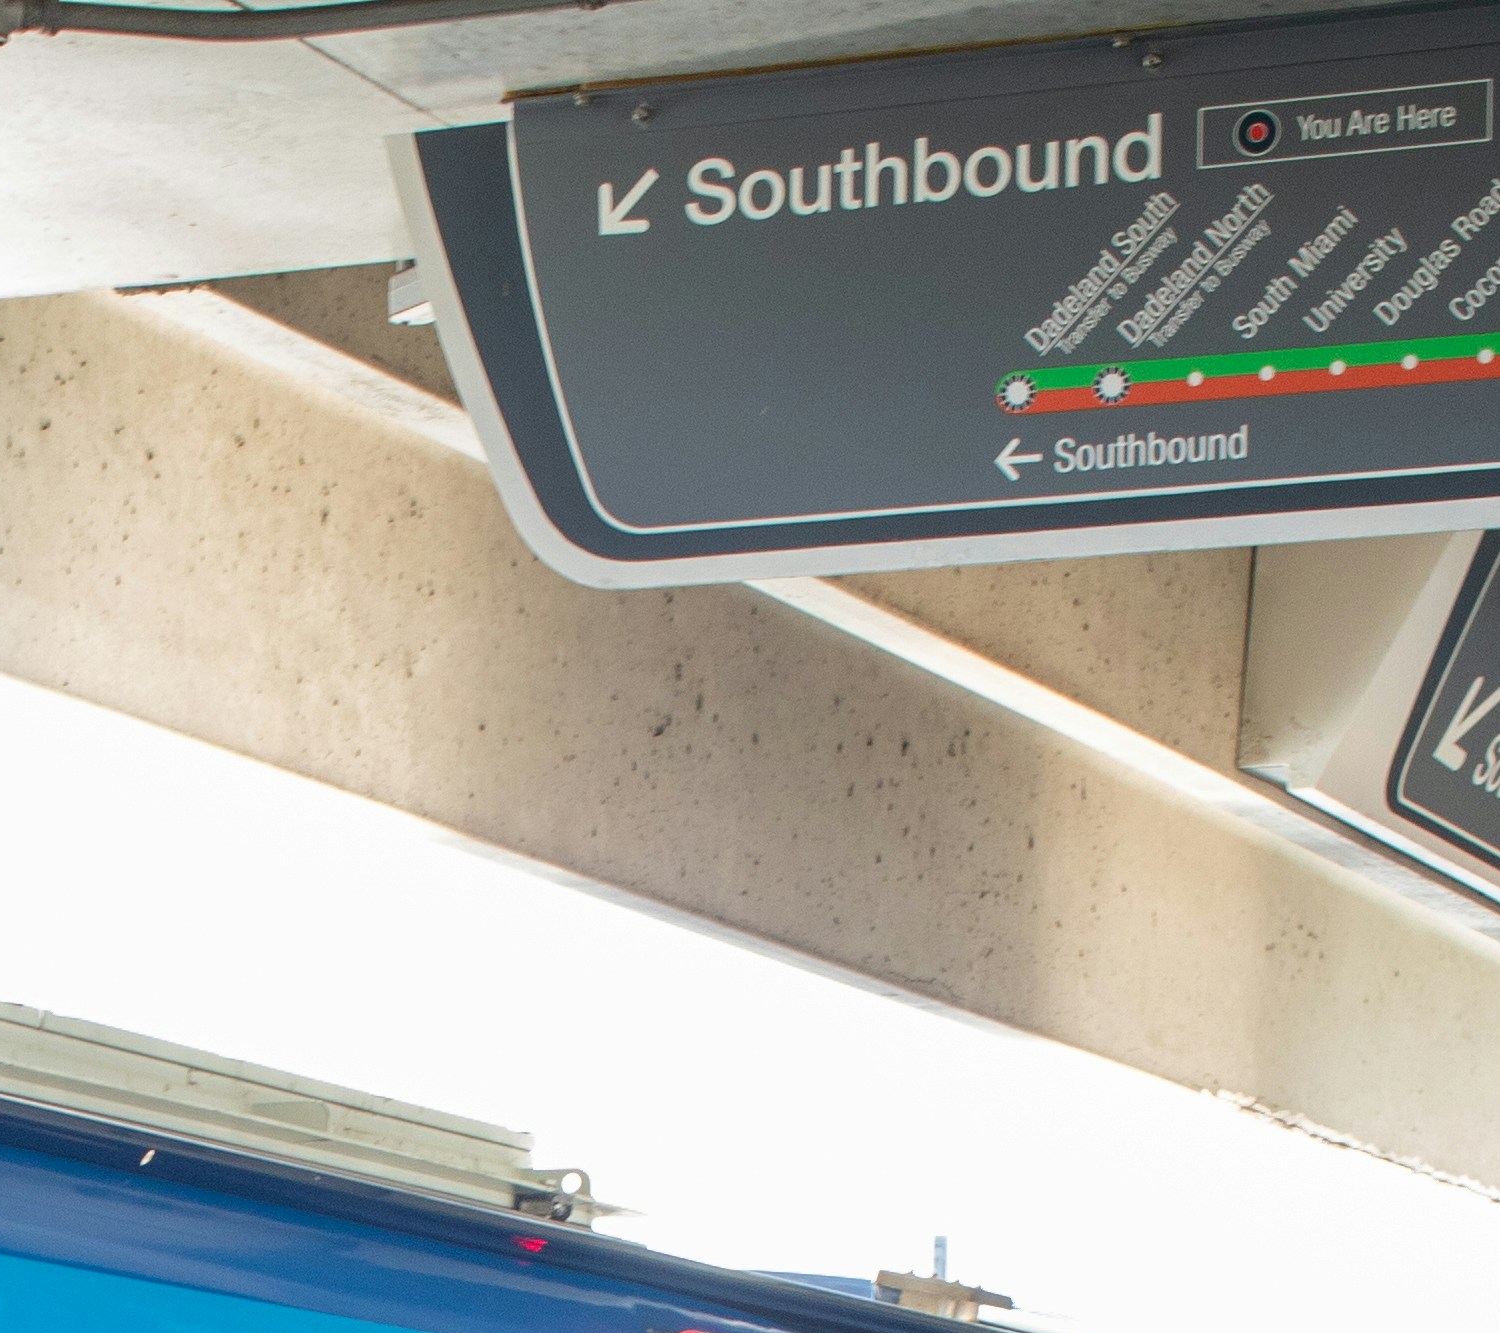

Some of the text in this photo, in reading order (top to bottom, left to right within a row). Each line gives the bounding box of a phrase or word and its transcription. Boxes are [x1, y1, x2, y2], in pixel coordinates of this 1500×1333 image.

[683, 112, 1162, 225] Southbound
[1296, 102, 1458, 142] You Are Here
[1024, 191, 1177, 353] Dadeland South
[1057, 226, 1178, 354] Transfer to Busway
[1116, 183, 1270, 345] Dadeland North
[1148, 219, 1271, 347] Transfer to Busway
[1231, 205, 1359, 339] South Miami
[1302, 227, 1408, 332] University
[1372, 239, 1461, 326] Douglas
[1053, 424, 1248, 474] Southbound
